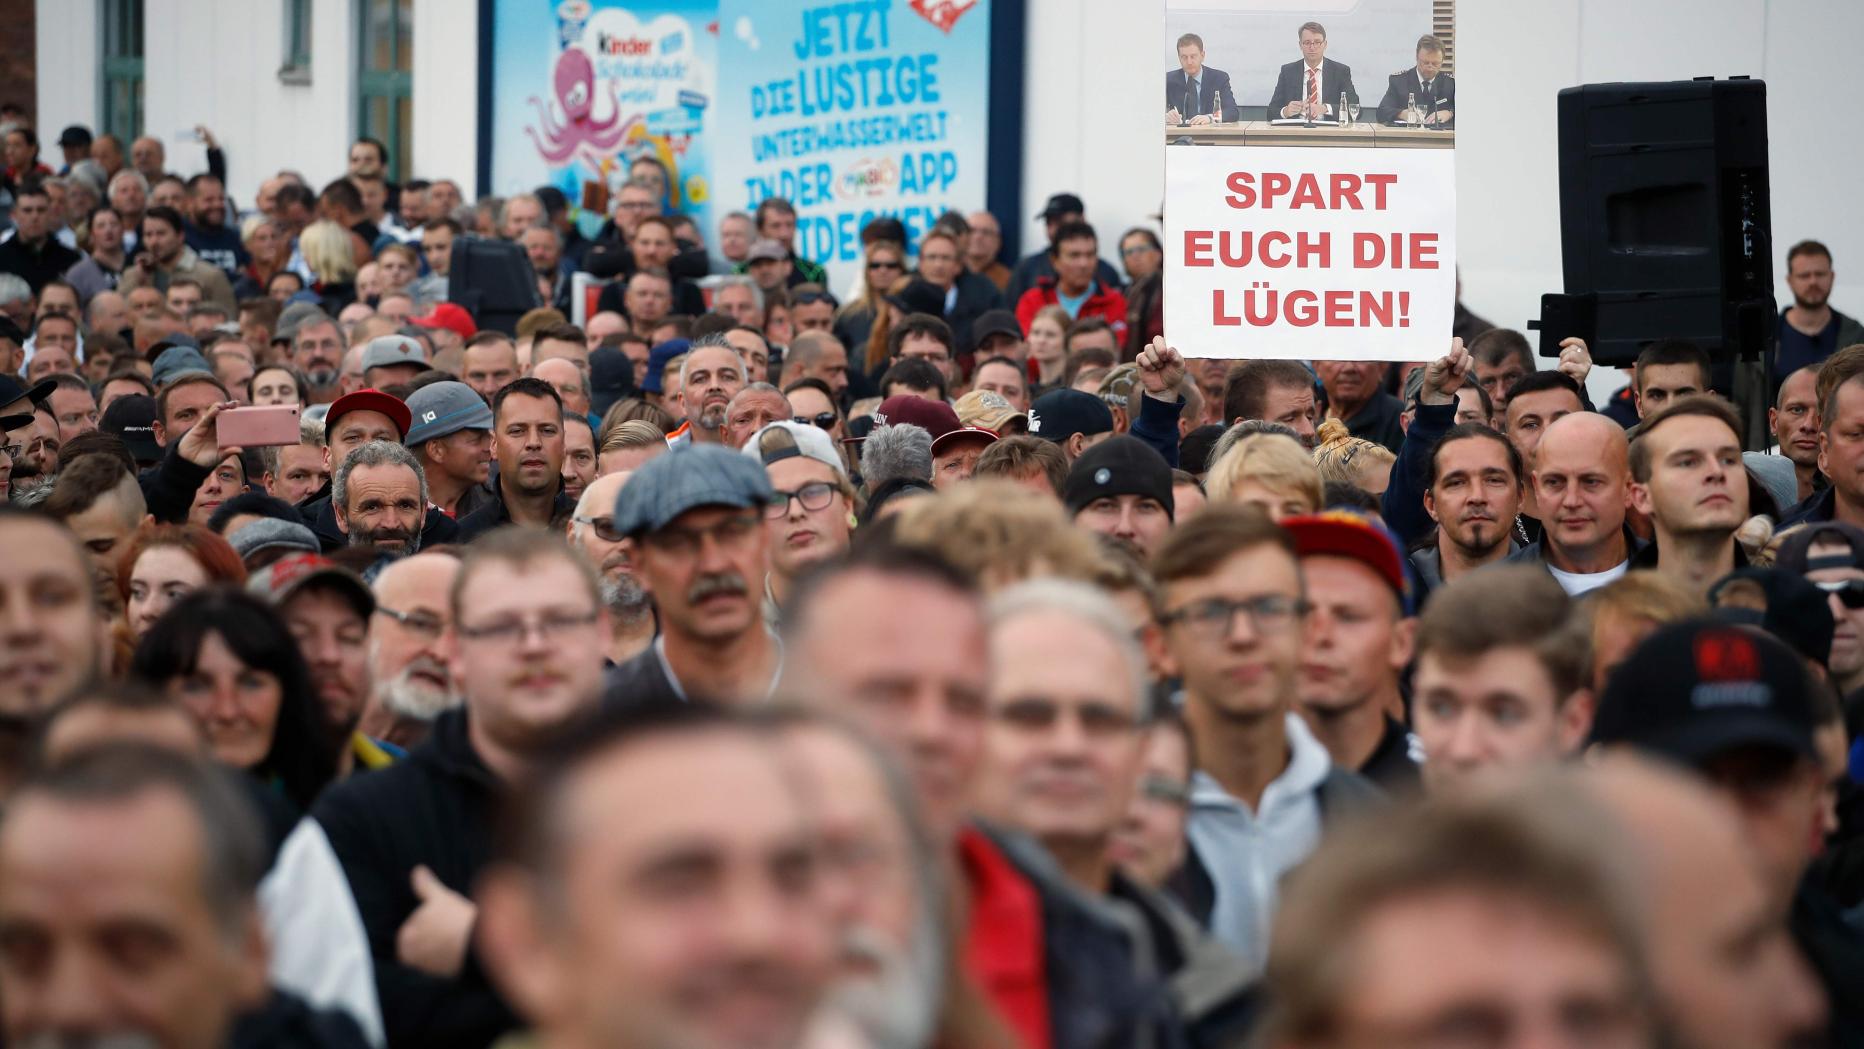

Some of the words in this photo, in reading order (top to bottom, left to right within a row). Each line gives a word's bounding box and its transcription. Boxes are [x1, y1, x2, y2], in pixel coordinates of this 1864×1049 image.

[795, 0, 892, 60] JETZT
[752, 80, 795, 118] DIE
[799, 54, 940, 116] LUSTIGE
[752, 111, 948, 163] UNTERWASSERWELT
[745, 174, 776, 210] IN
[780, 163, 833, 206] DER
[899, 151, 957, 195] APP
[1225, 171, 1398, 210] SPART
[1183, 230, 1331, 269] EUCH
[1353, 232, 1440, 270] DIE
[1212, 281, 1411, 328] LÜGEN!
